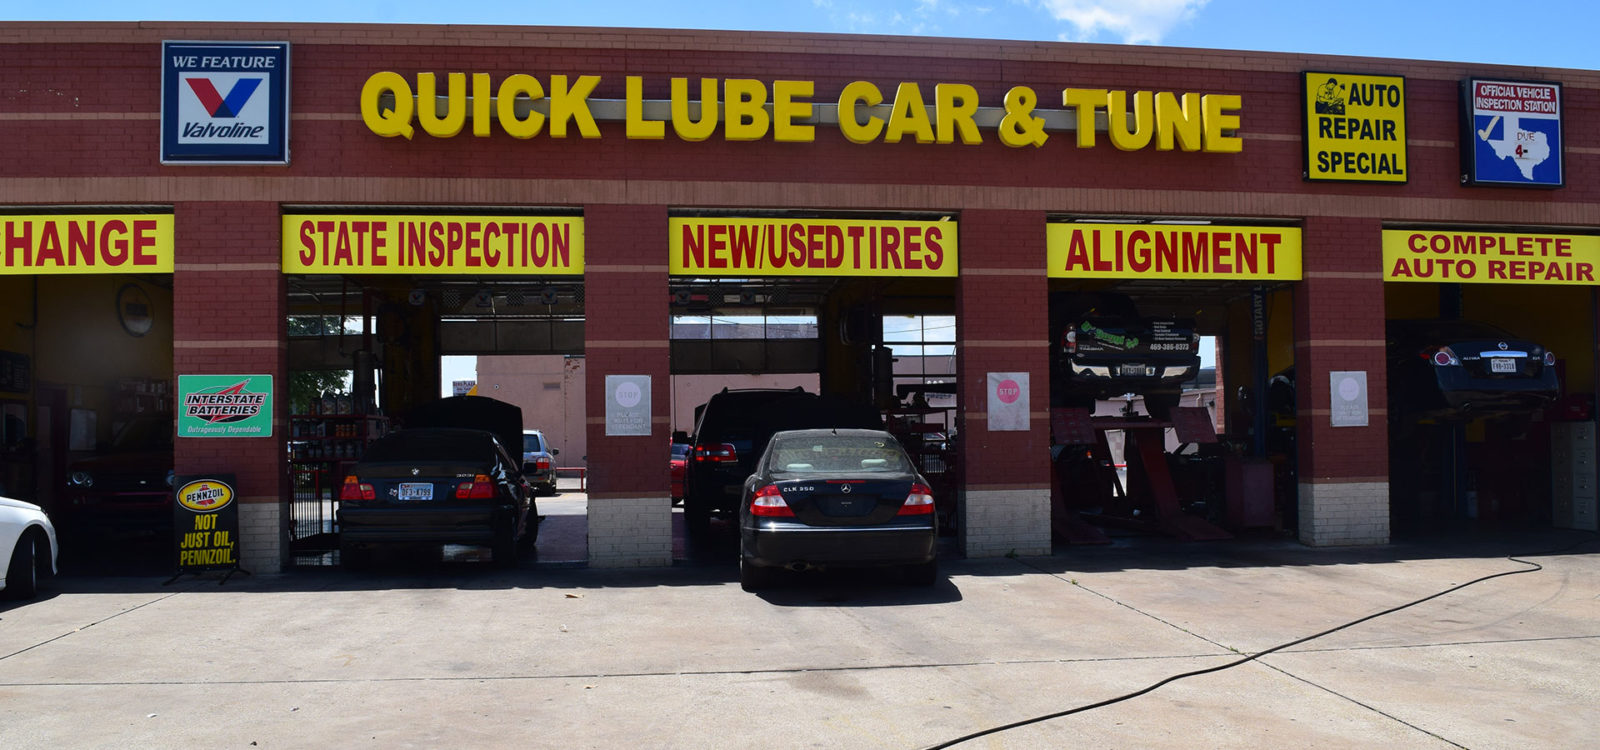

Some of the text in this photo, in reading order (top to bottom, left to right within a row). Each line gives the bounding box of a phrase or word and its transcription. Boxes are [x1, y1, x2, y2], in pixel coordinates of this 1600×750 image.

[173, 56, 276, 68] WE FEATURE
[1348, 82, 1400, 108] AUTO
[1480, 85, 1551, 99] OFFICIAL VEHICLE
[361, 71, 1244, 154] QUICK LUBE CAR & TUNE
[1476, 97, 1556, 112] INSPECTION STATION
[182, 122, 265, 138] Valvoline
[1319, 116, 1397, 141] REPAIR
[1317, 150, 1403, 175] SPECIAL
[0, 219, 157, 267] HANGE
[298, 220, 570, 267] STATE INSPECTION
[1065, 229, 1281, 274] ALIGNMENT
[1407, 233, 1572, 257] COMPLETE
[1391, 257, 1595, 282] AUTO REPAIR
[187, 395, 264, 404] INTERSTATE
[189, 405, 258, 414] BATTERIES
[187, 426, 261, 434] Outrageously Dependable
[186, 488, 224, 503] PENNZOIL
[194, 513, 218, 531] NOT
[180, 531, 235, 550] JUST OIL,
[180, 548, 237, 566] PENNZOIL.
